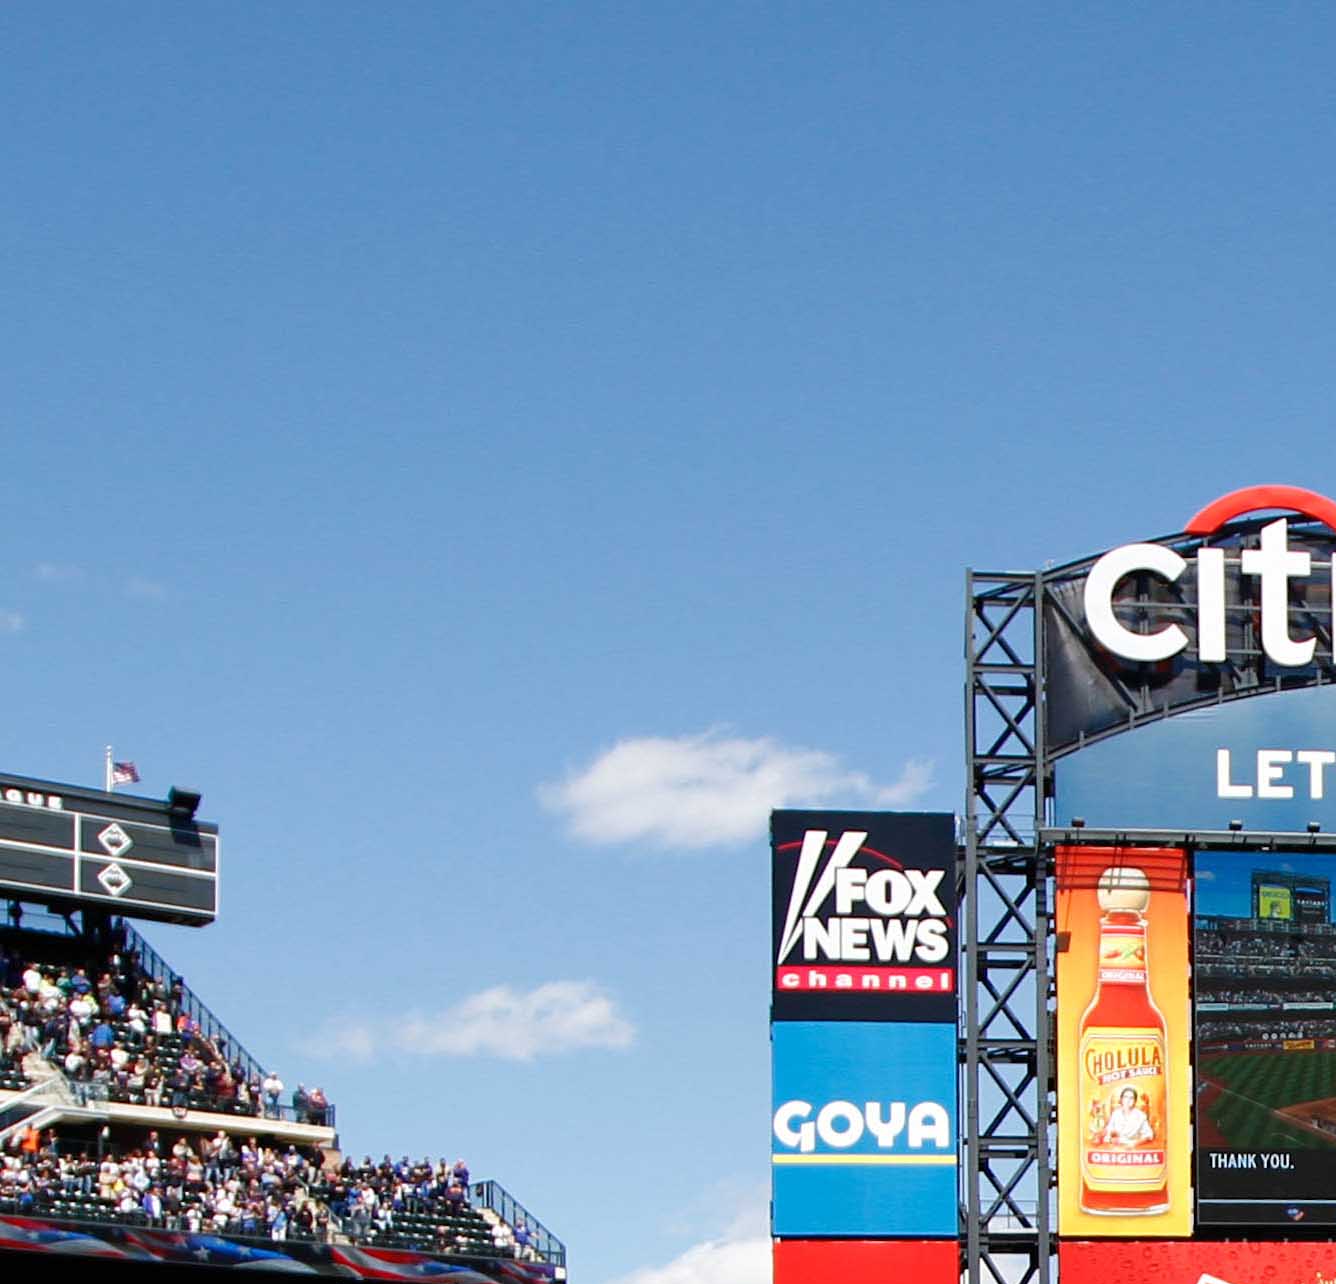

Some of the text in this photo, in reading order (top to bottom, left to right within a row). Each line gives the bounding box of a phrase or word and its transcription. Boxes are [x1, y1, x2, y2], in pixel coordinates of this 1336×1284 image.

[835, 868, 946, 915] FOX
[803, 916, 949, 961] NEWS
[782, 971, 950, 990] channel
[1085, 1046, 1162, 1081] CHOLULA
[773, 1100, 949, 1152] GOYA
[1091, 1152, 1161, 1164] ORIGINAL
[1210, 1153, 1295, 1170] THANK YOU.
